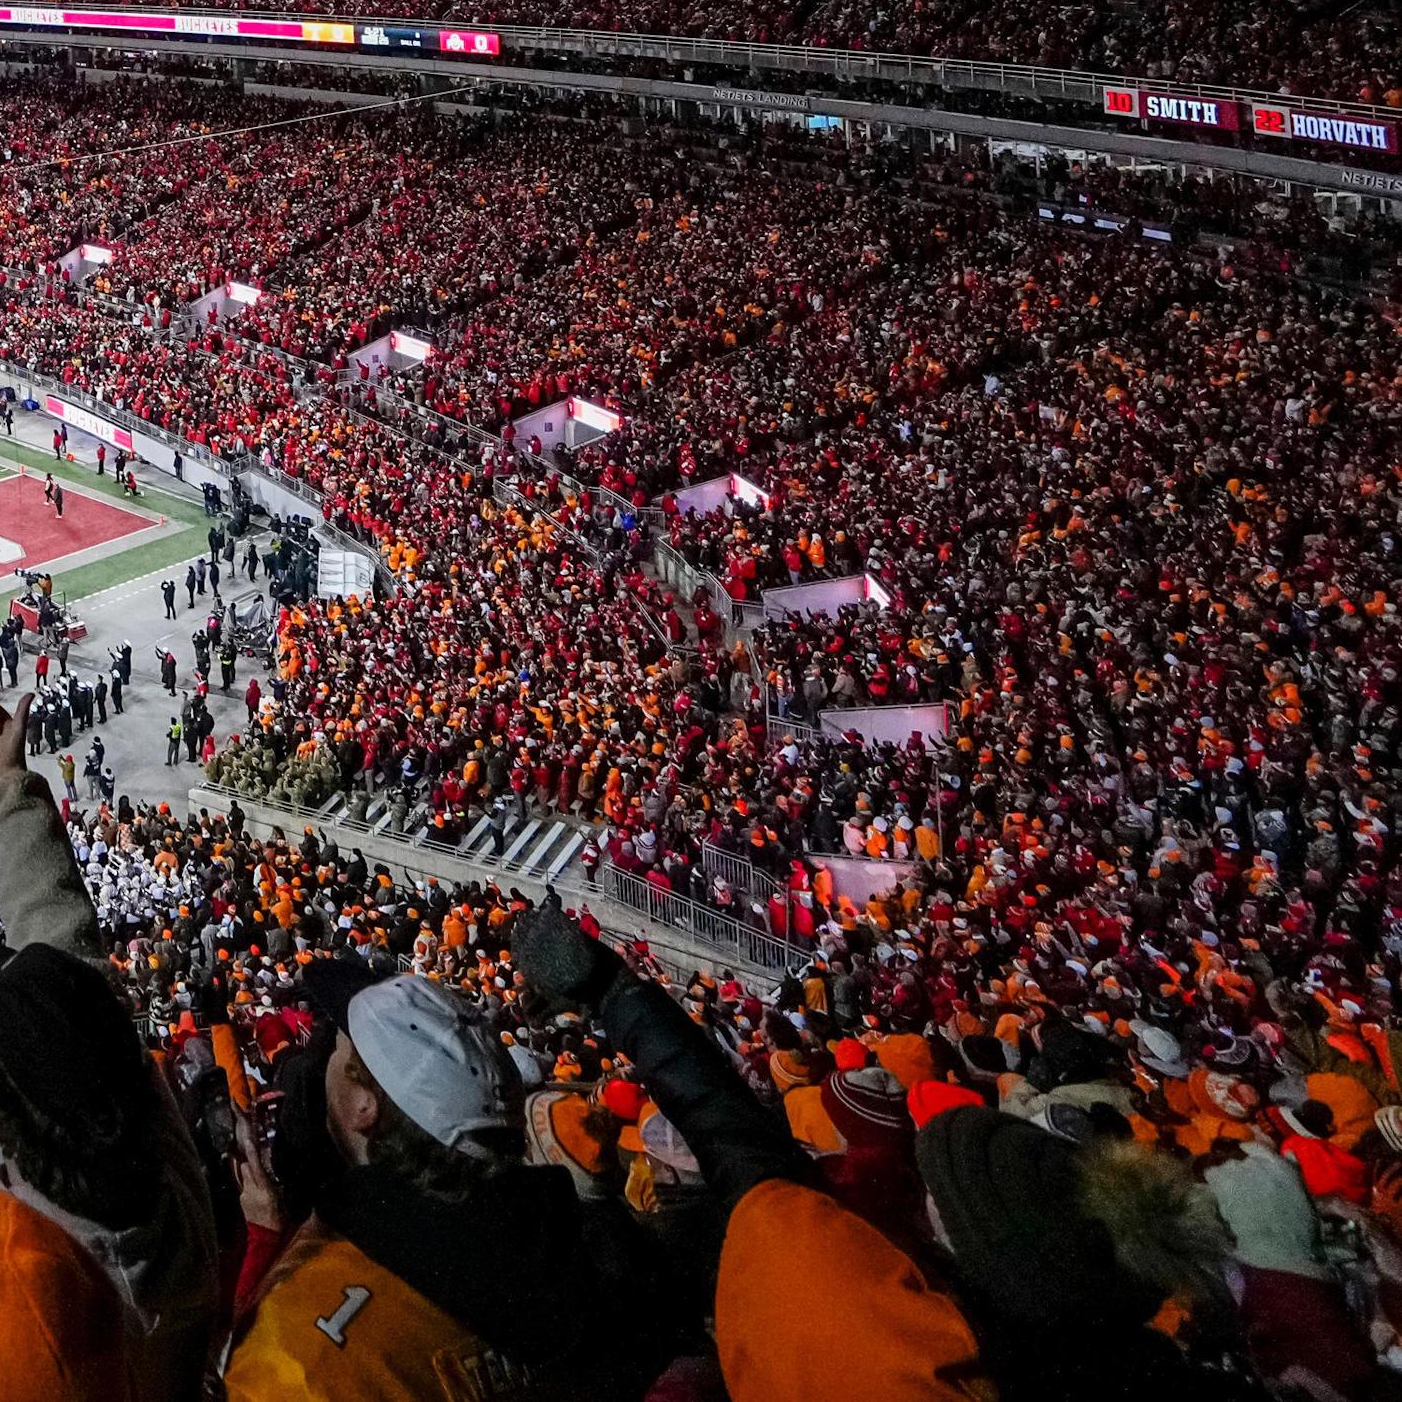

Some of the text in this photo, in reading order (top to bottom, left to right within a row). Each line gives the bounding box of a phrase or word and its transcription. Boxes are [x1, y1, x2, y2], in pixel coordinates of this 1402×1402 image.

[758, 94, 808, 107] LANDING
[1106, 91, 1219, 126] 10 SMITH
[1254, 110, 1388, 150] 22 HORVATH
[315, 1285, 372, 1346] 1
